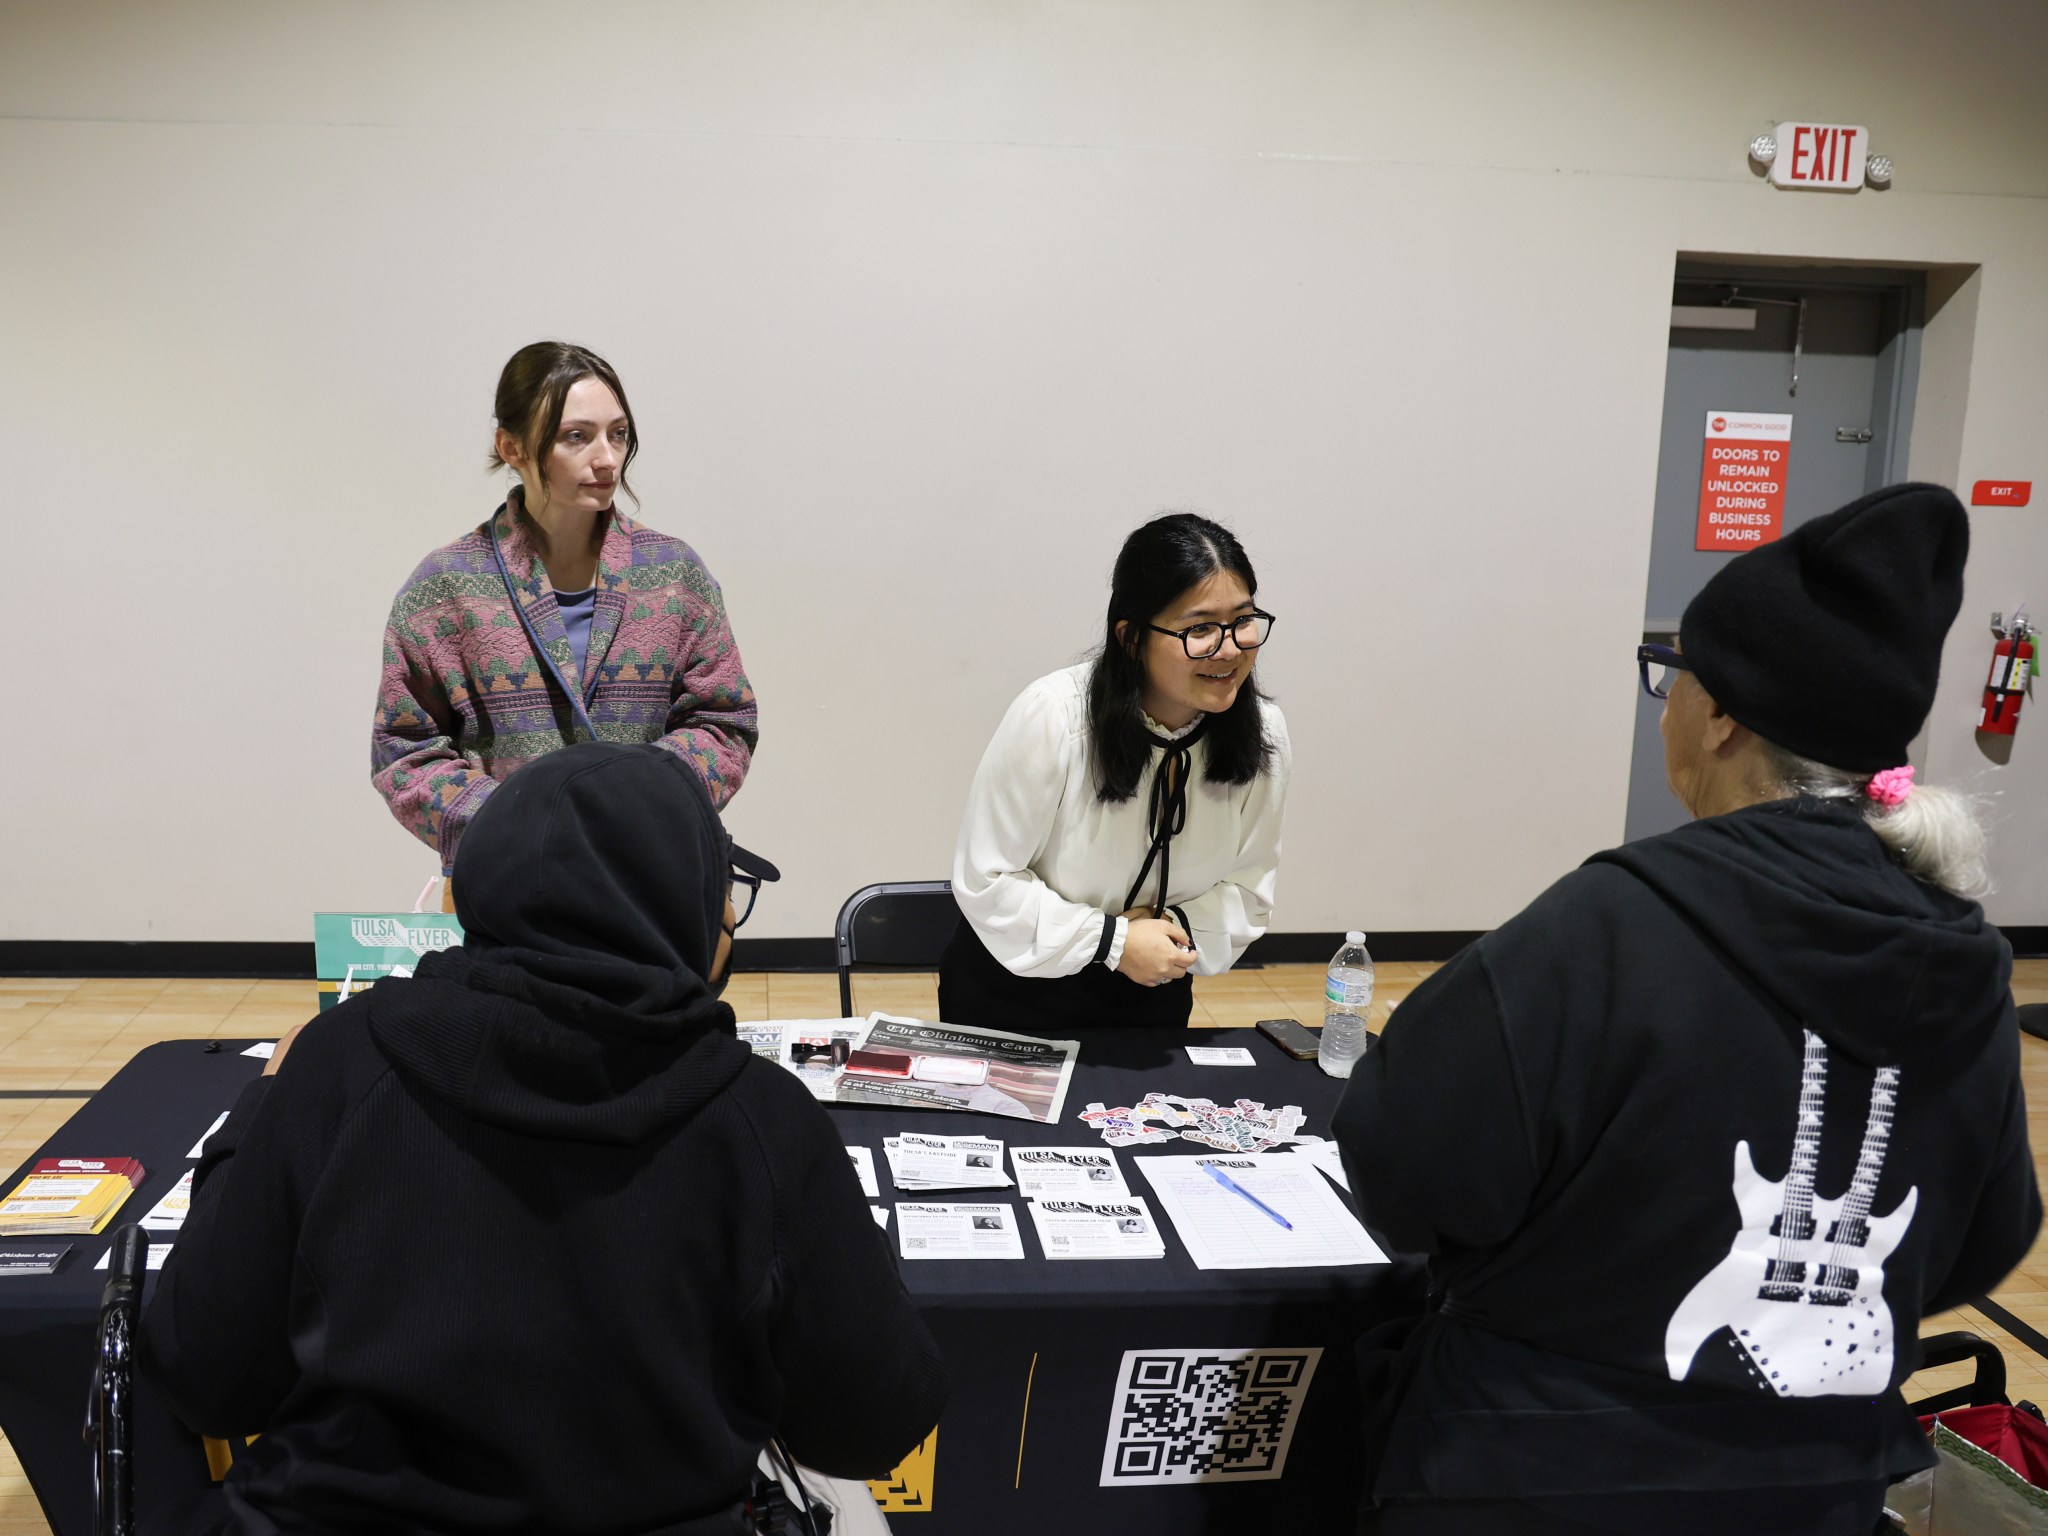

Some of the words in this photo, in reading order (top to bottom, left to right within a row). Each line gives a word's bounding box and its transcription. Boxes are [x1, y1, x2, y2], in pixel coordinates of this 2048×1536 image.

[1791, 126, 1857, 182] EXIT
[1728, 422, 1762, 430] COMMON
[1765, 423, 1787, 431] GOOD
[1712, 448, 1758, 461] DOORS
[1763, 449, 1780, 462] TO
[1720, 464, 1770, 477] REMAIN
[1708, 480, 1779, 494] UNLOCKED
[1991, 486, 2013, 496] EXIT
[1716, 496, 1767, 509] DURING
[1709, 512, 1771, 525] BUSINESS
[1716, 529, 1761, 541] HOURS
[353, 919, 397, 937] TULSA
[407, 929, 450, 946] FLYER
[886, 1023, 917, 1036] The
[919, 1029, 997, 1048] Oklahoma
[1001, 1041, 1045, 1054] Eagle
[853, 1081, 863, 1089] at
[864, 1084, 883, 1092] war
[884, 1086, 905, 1095] with
[906, 1089, 922, 1098] the
[923, 1093, 962, 1105] system.
[873, 1080, 897, 1088] Chad
[898, 1084, 930, 1094] Cherry
[1019, 1151, 1056, 1161] TULSA
[1063, 1155, 1101, 1165] FLYER
[1042, 1201, 1081, 1210] TULSA
[1091, 1205, 1130, 1214] FLYER
